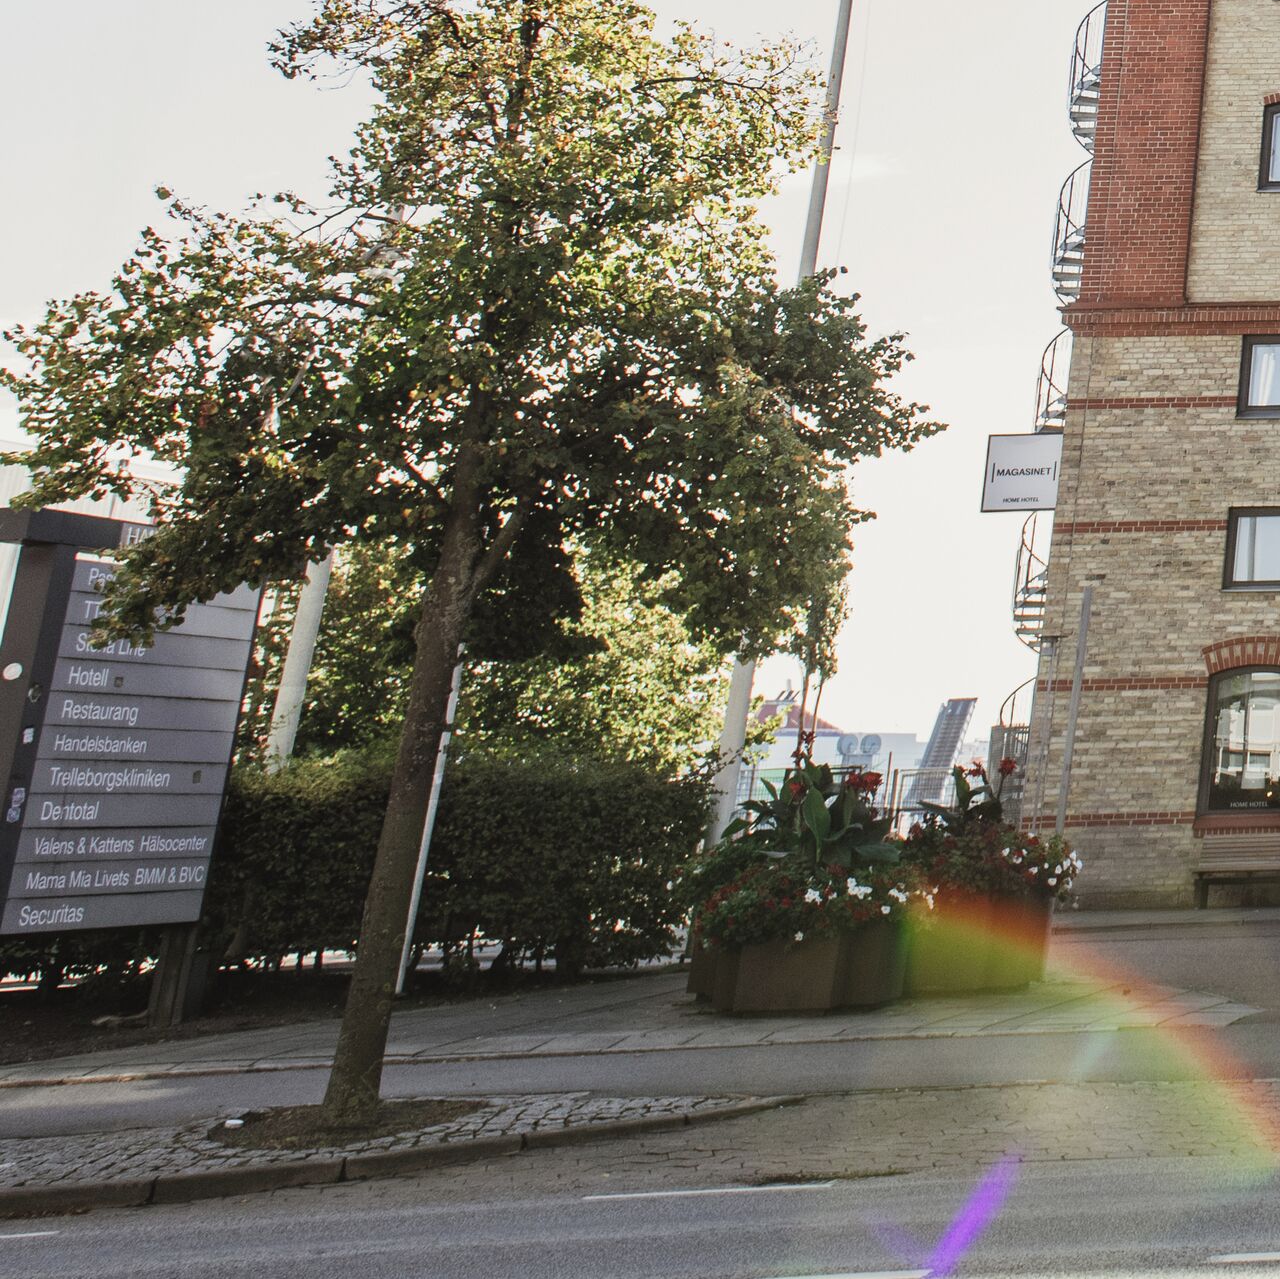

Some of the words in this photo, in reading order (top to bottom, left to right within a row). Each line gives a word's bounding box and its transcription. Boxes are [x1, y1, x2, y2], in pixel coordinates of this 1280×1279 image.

[996, 467, 1051, 476] MAGASINET
[68, 666, 109, 687] Hotell
[61, 700, 139, 726] Restaurang
[54, 734, 147, 754] Handelsbanken
[50, 767, 170, 792] Trelleborgskliniken
[40, 801, 100, 821] Dentotal
[35, 837, 74, 855] Valens
[77, 837, 86, 854] &
[89, 836, 134, 853] Kattens
[139, 835, 207, 852] Hälsocenter
[25, 872, 66, 890] Mama
[69, 871, 92, 888] Mia
[94, 870, 129, 887] Livets
[135, 868, 166, 885] BMM
[168, 867, 176, 883] &
[179, 866, 205, 883] BVC
[19, 904, 85, 927] Securitas
